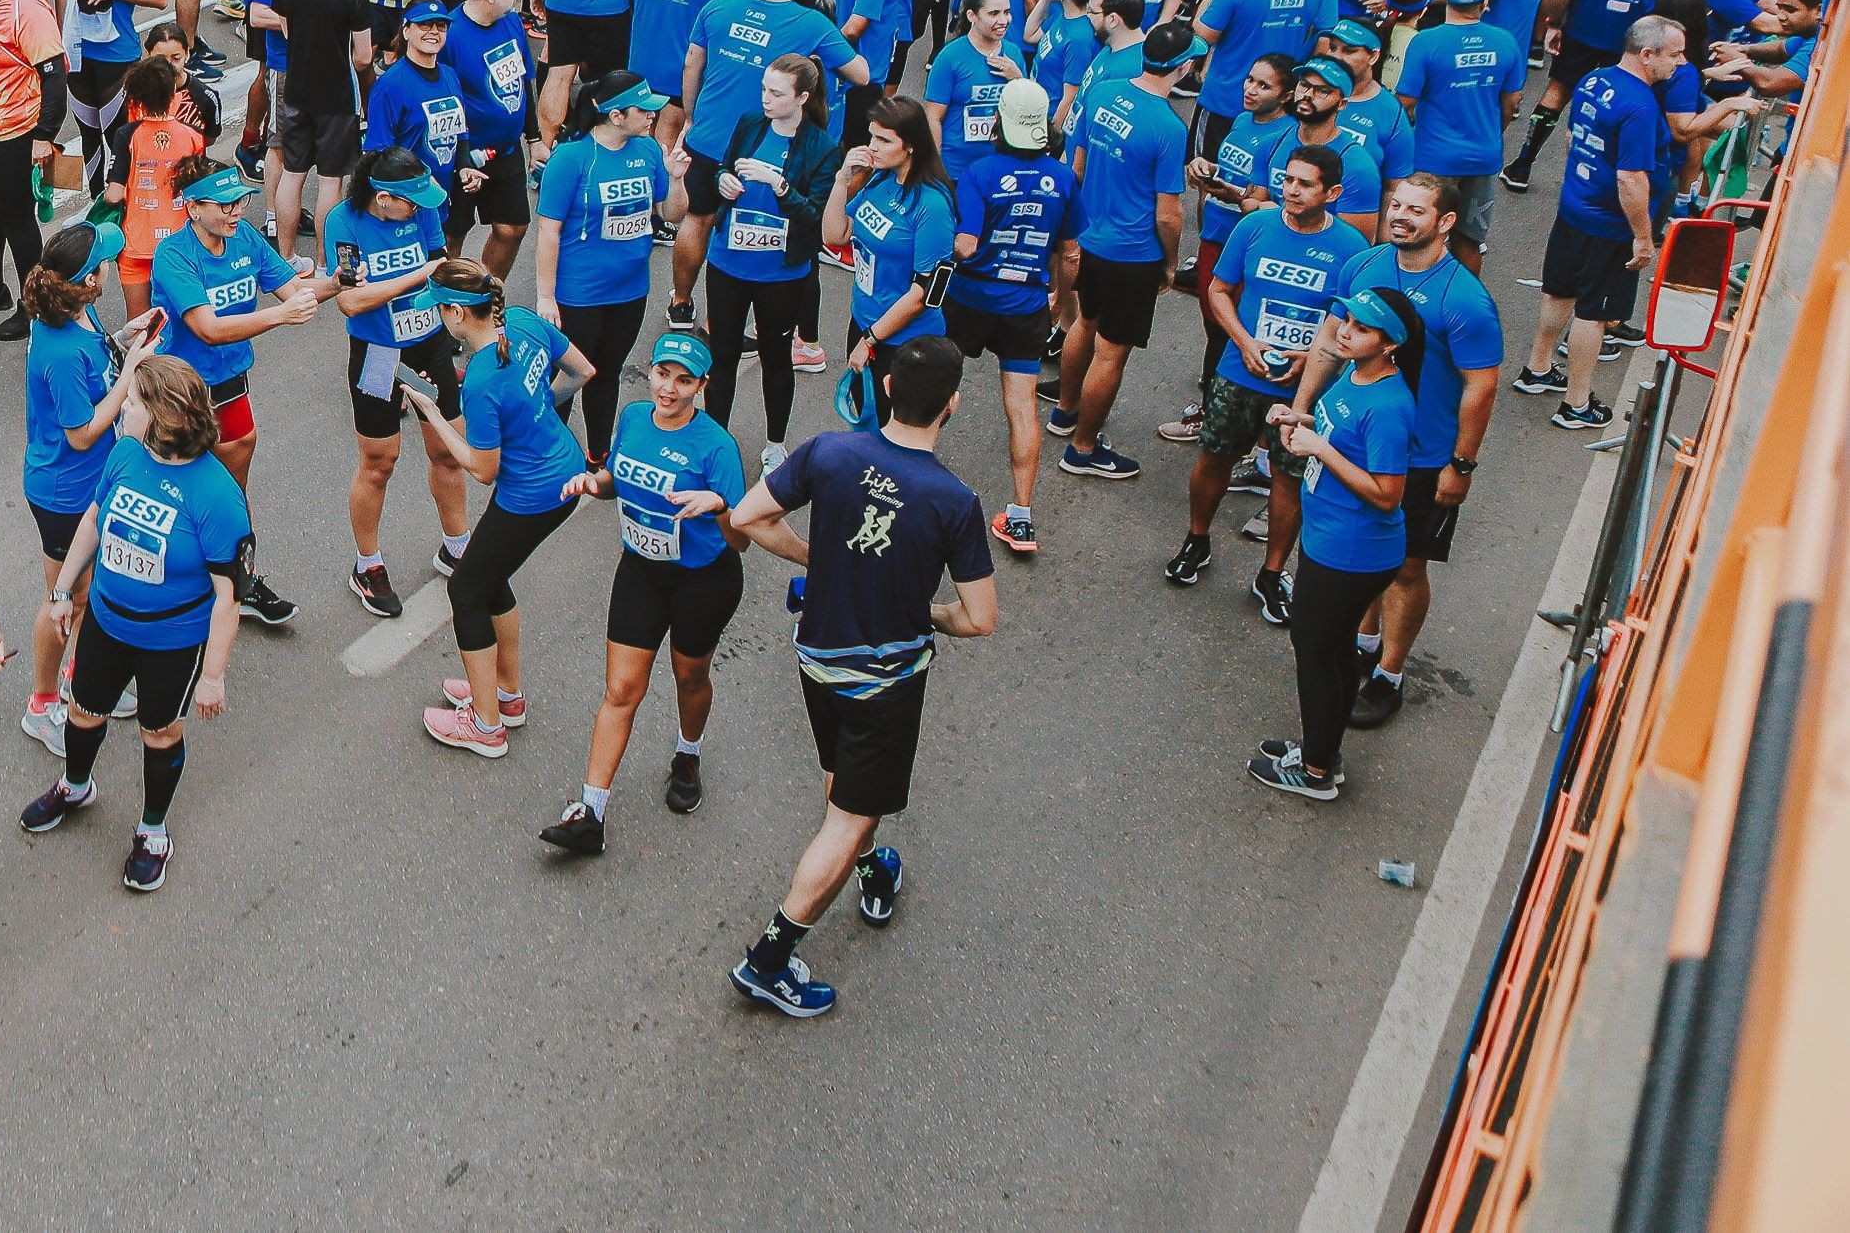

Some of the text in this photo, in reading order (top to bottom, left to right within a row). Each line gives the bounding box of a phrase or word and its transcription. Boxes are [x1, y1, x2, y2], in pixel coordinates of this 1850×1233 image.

[733, 26, 768, 45] SESI
[1459, 53, 1494, 67] SESI
[494, 62, 519, 82] 633
[977, 87, 1003, 101] SES
[432, 116, 464, 135] 1274
[1098, 111, 1130, 137] SESI
[1220, 145, 1251, 171] SESI
[607, 180, 649, 199] SESI
[1013, 204, 1040, 215] SESI
[608, 218, 649, 236] 10259
[859, 207, 889, 237] SESI
[733, 229, 782, 249] 9246
[375, 248, 423, 271] SESI
[1262, 261, 1323, 287] SESI
[214, 279, 254, 309] SESI
[395, 314, 436, 336] 11537
[1262, 322, 1313, 346] 1486
[528, 351, 546, 391] SESI
[619, 460, 667, 491] SESI
[859, 466, 900, 495] Life
[116, 491, 173, 529] SESI
[868, 488, 905, 509] Running
[105, 542, 156, 577] 13137
[773, 977, 804, 1006] FILA
